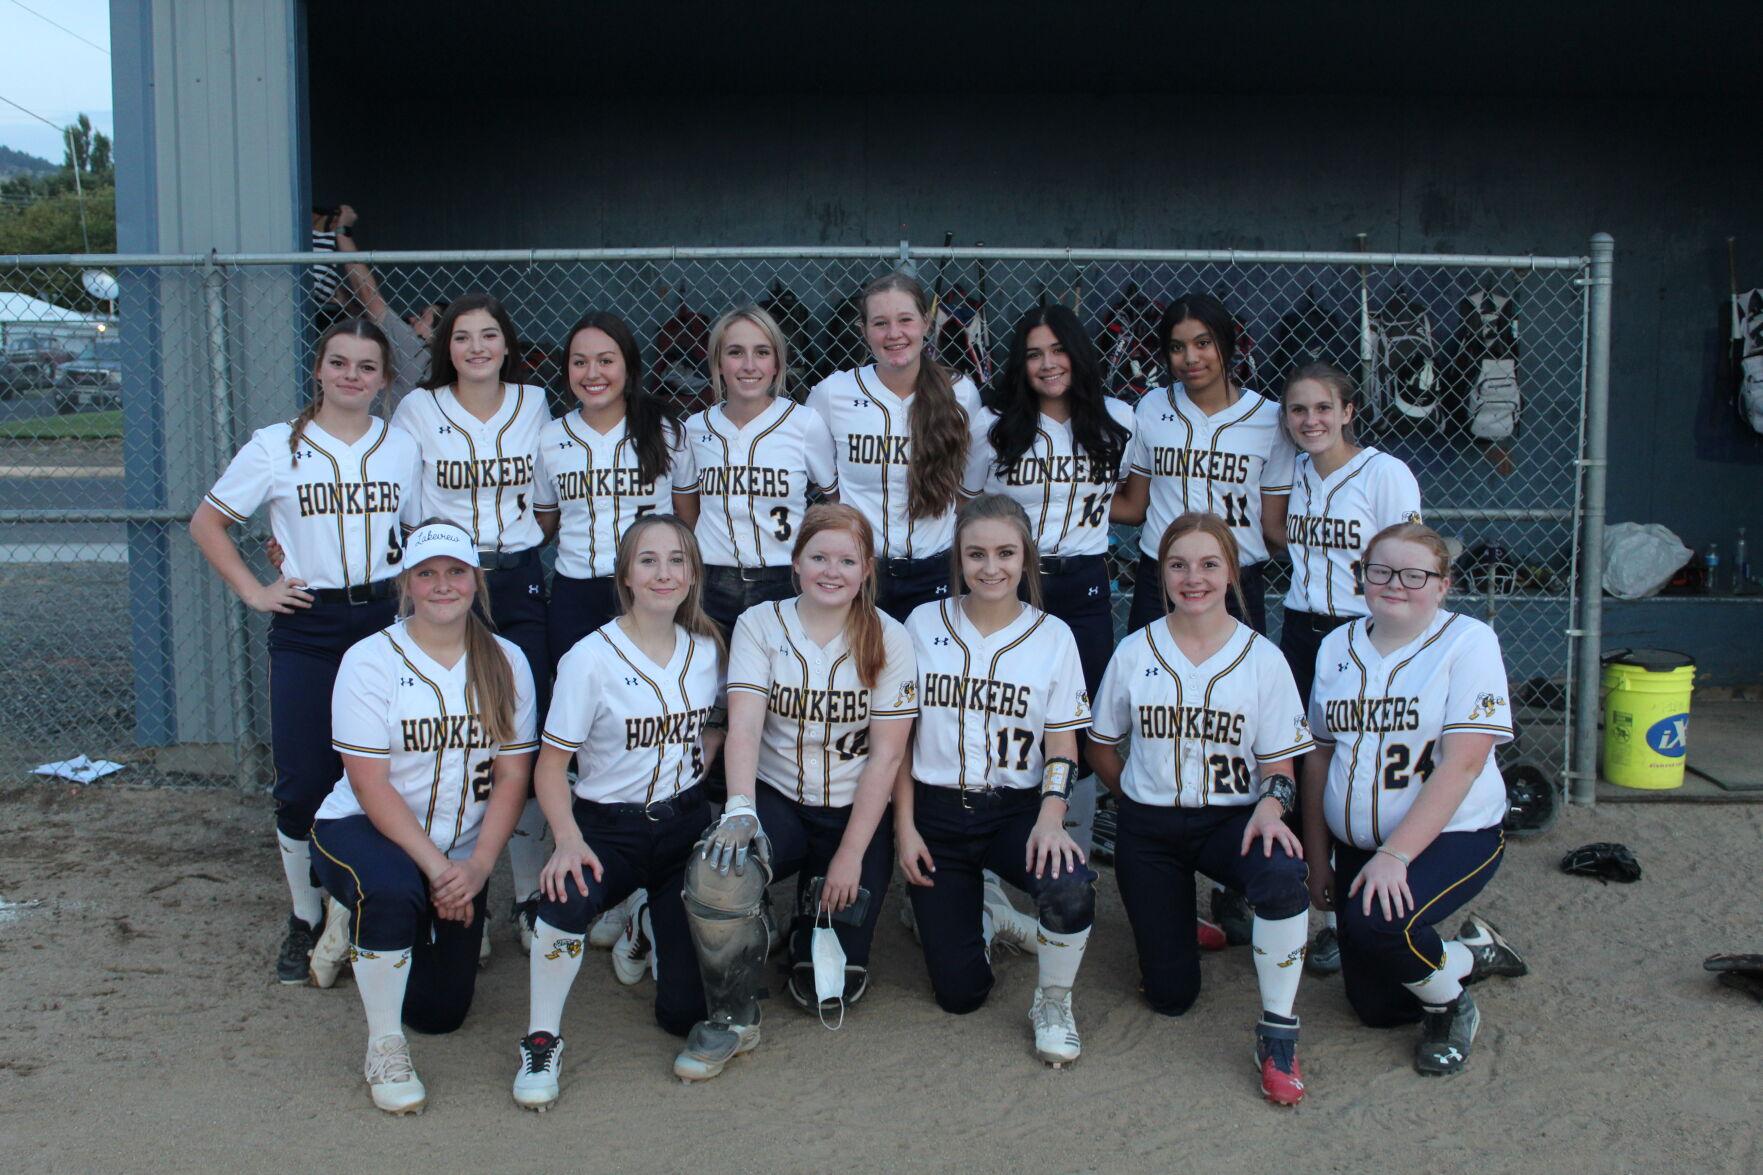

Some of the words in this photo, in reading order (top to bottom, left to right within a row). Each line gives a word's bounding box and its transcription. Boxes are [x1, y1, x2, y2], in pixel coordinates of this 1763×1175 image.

[848, 433, 911, 465] HONK
[1154, 446, 1250, 484] HONKERS
[436, 453, 534, 489] HONKERS
[297, 481, 400, 517] HONKERS
[1078, 493, 1113, 527] 16
[1221, 493, 1250, 527] 11
[415, 530, 460, 546] Lakeview
[770, 506, 792, 542] 3
[1287, 513, 1361, 549] ONKERS
[767, 680, 869, 723] HONKERS
[924, 673, 1030, 718] HONKERS
[400, 714, 494, 752] HONKE
[625, 705, 711, 750] HONKER
[1138, 705, 1245, 746] HONKERS
[1326, 696, 1420, 733] HONKERS
[997, 727, 1034, 771] 17
[1384, 740, 1435, 790] 24
[1209, 754, 1251, 794] 20
